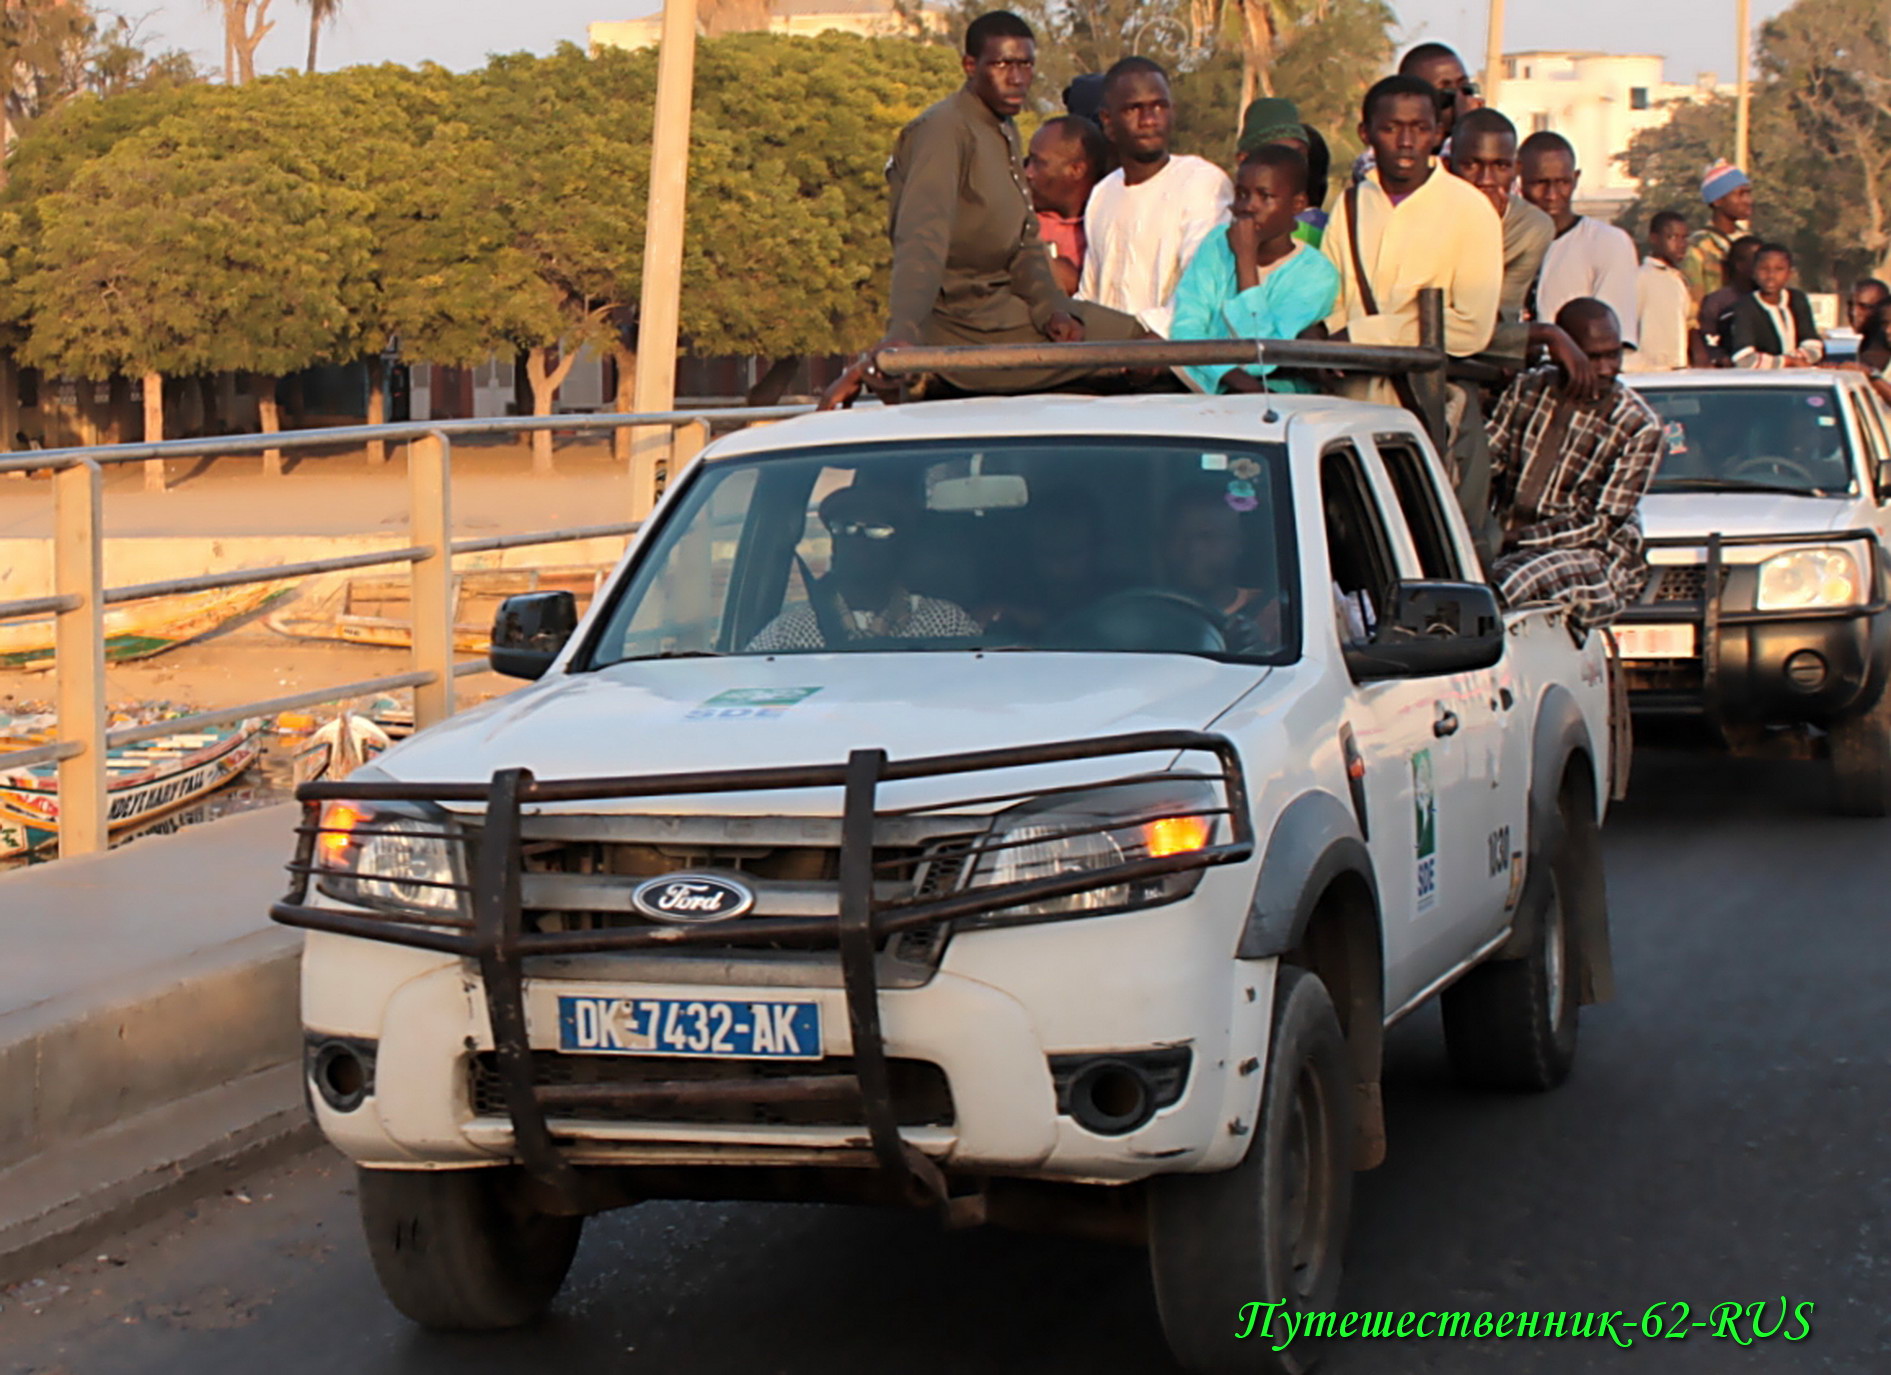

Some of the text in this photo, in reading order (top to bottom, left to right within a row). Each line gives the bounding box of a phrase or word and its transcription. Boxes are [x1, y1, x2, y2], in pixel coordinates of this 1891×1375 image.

[658, 883, 725, 911] Ford
[1418, 857, 1435, 897] SDE
[575, 999, 801, 1054] DK-7432-AK
